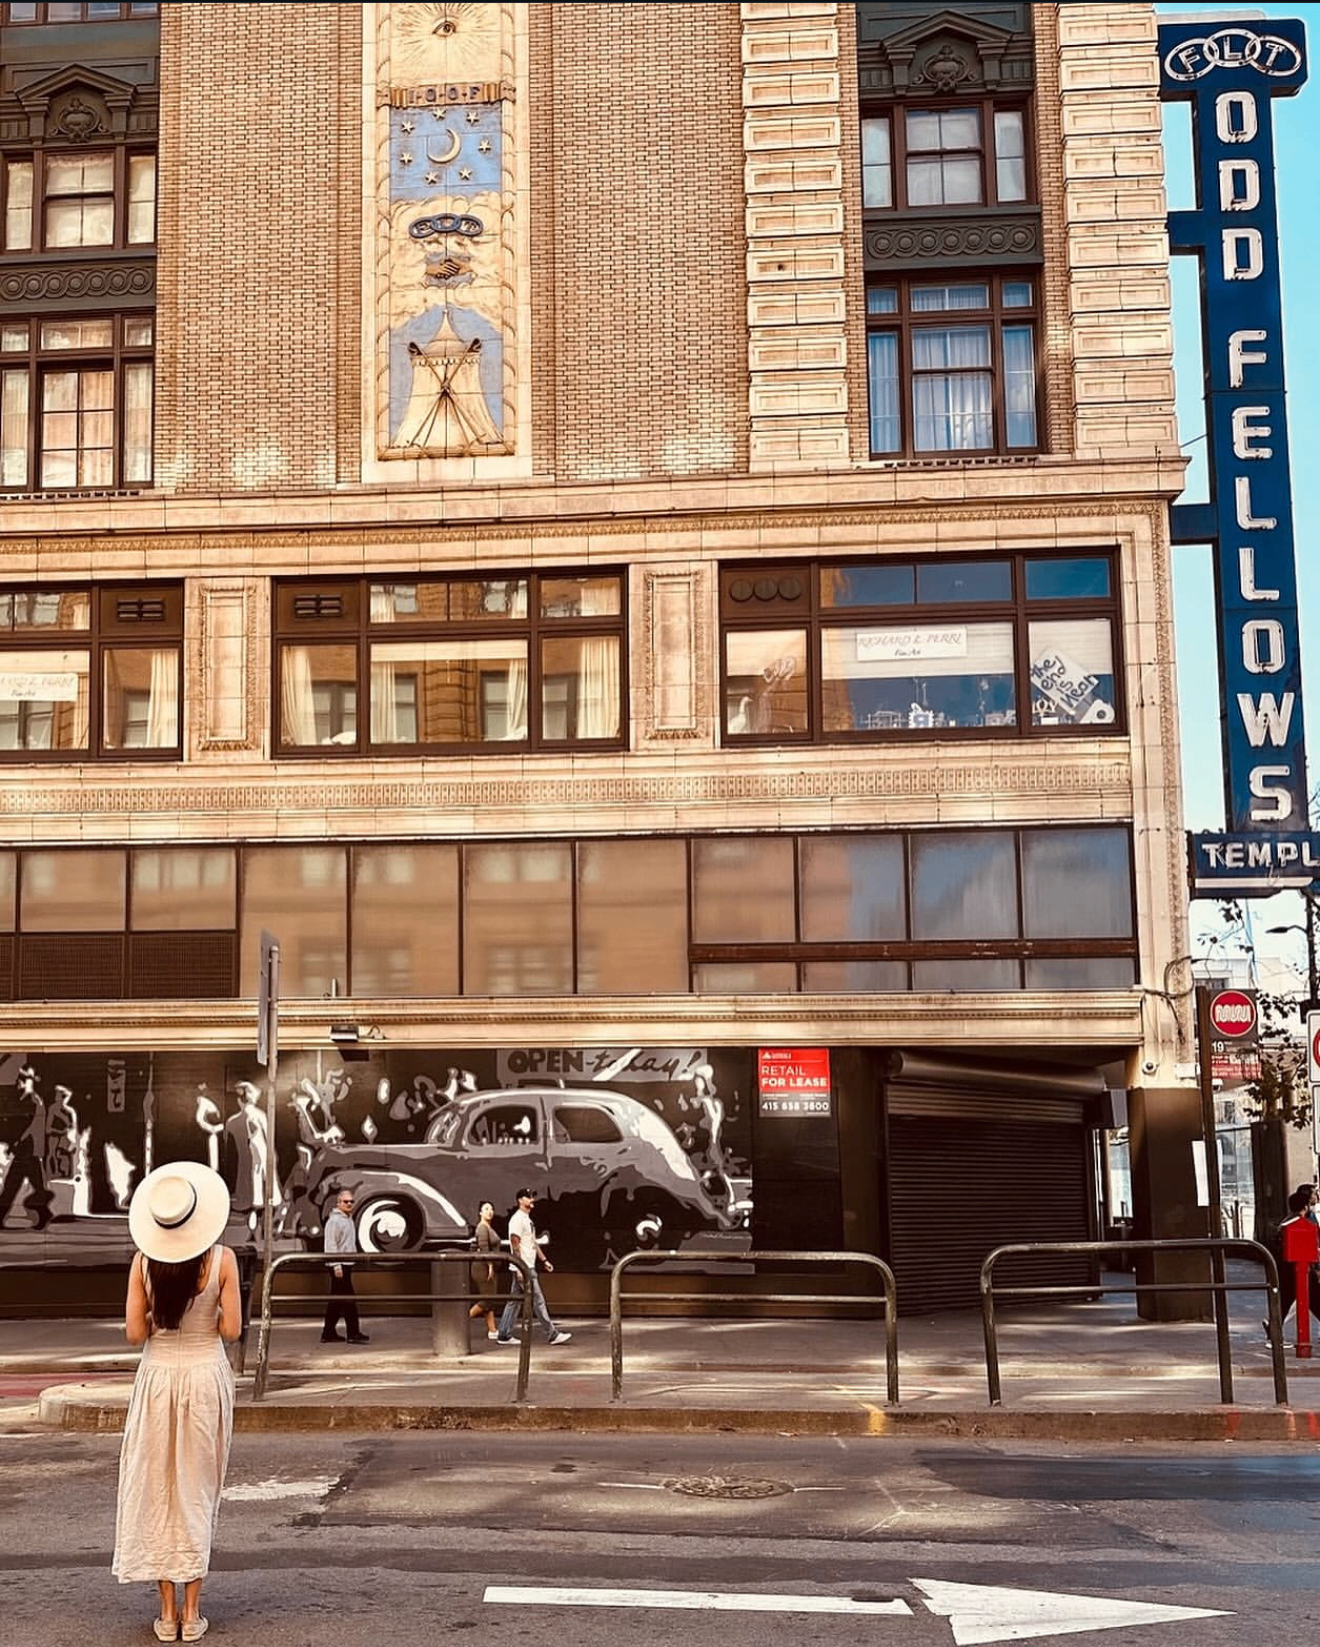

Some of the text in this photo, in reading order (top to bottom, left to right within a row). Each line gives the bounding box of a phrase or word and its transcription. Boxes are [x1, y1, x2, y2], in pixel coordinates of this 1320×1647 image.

[1215, 91, 1295, 822] ODD FELLOWS
[1041, 655, 1066, 690] end
[1055, 680, 1074, 695] is
[1211, 1040, 1224, 1053] 19
[761, 1065, 806, 1077] RETAIL
[761, 1078, 828, 1088] FOR LEASE
